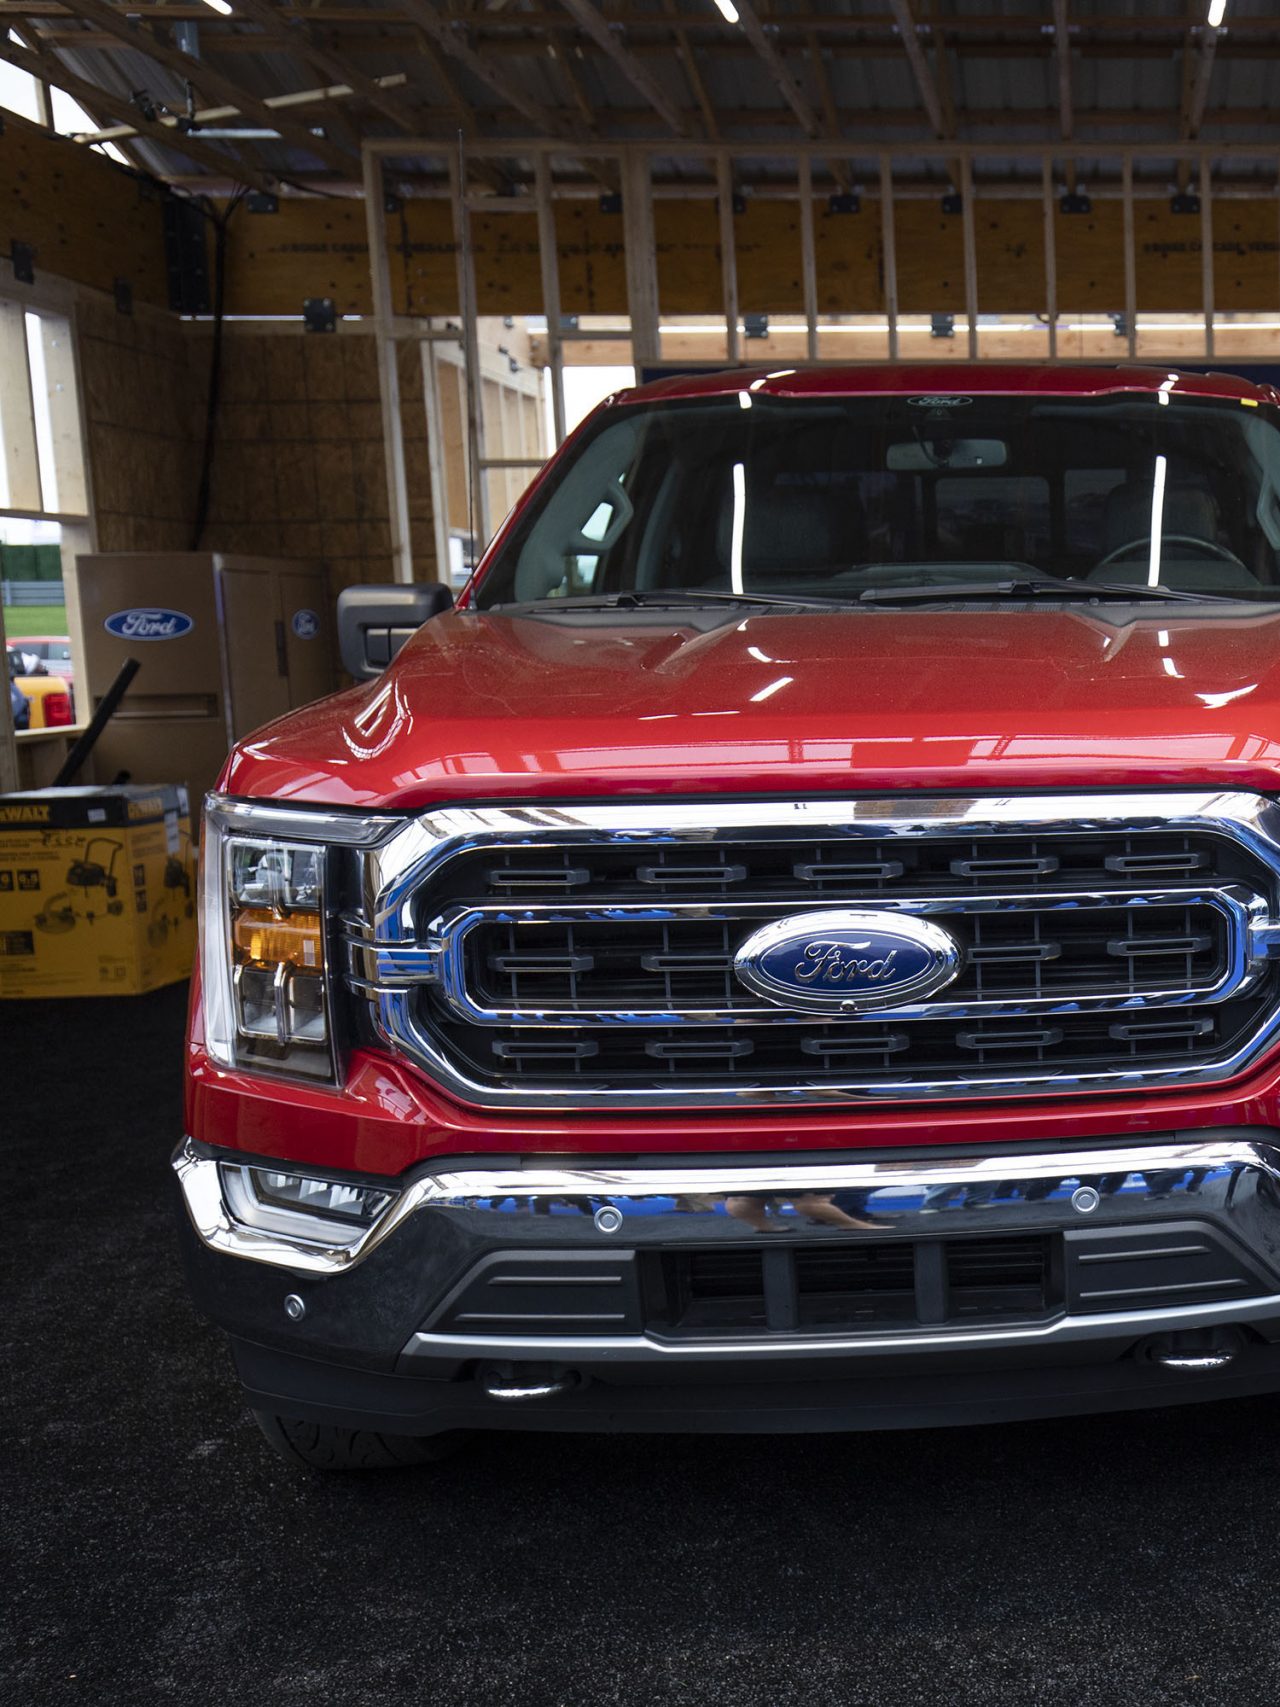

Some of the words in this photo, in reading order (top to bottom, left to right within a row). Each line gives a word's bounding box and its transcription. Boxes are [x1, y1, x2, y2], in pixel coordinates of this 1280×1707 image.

[918, 396, 961, 406] Ford
[122, 613, 177, 635] Ford
[795, 941, 897, 983] Ford
